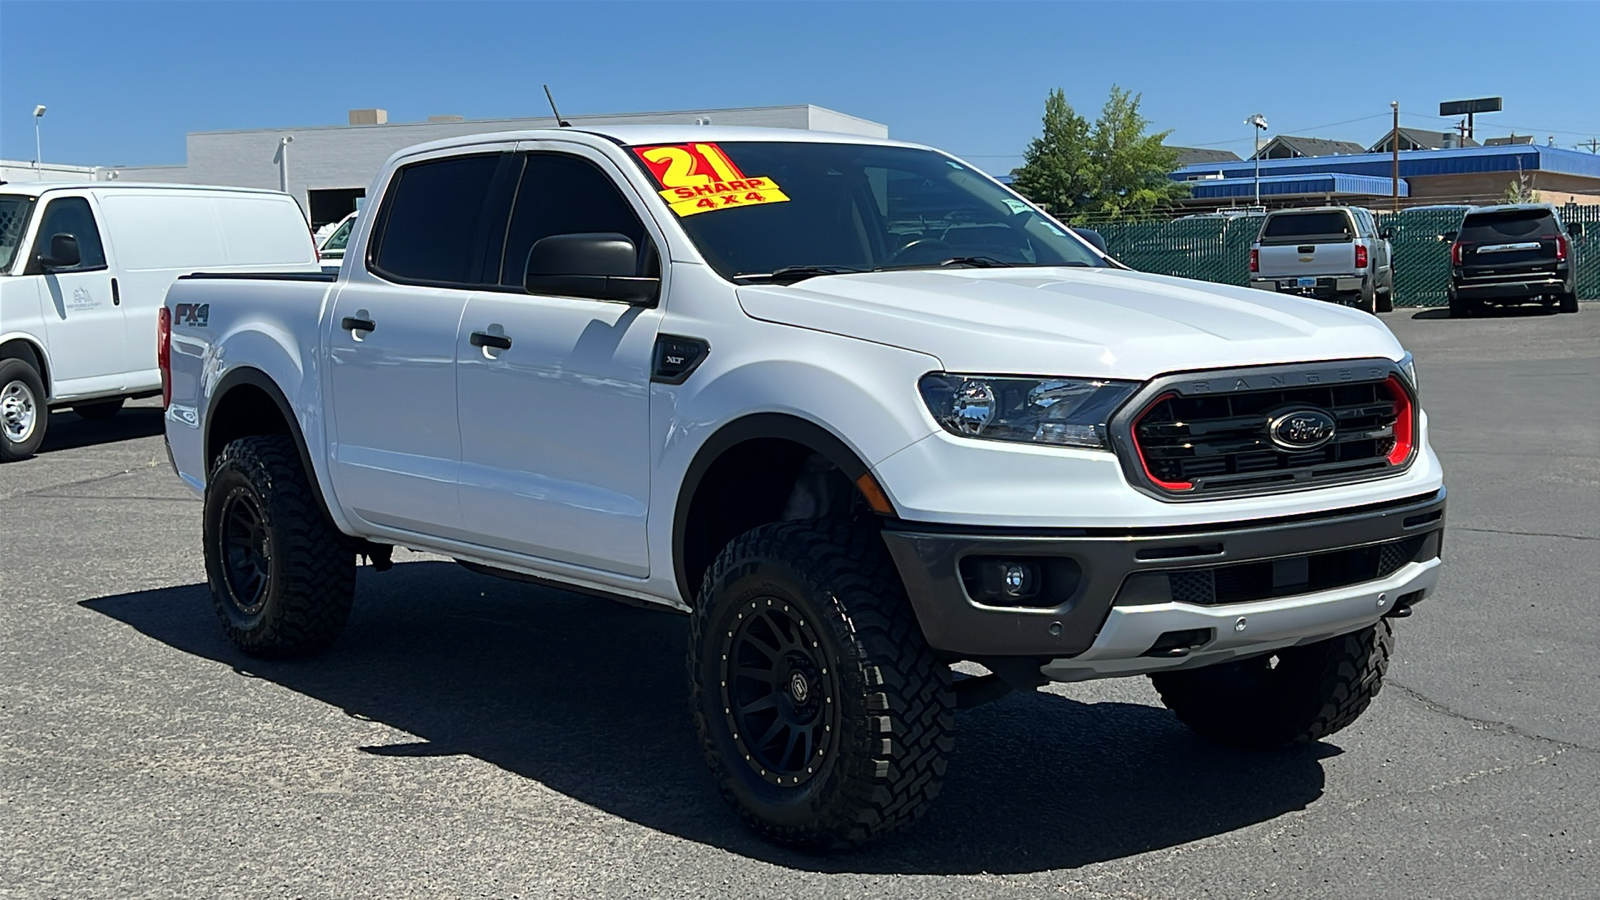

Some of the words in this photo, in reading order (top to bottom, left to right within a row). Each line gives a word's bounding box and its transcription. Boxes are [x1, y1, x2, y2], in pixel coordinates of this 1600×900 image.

[642, 144, 740, 187] 21
[674, 179, 764, 199] SHARP
[174, 303, 210, 324] FX4
[666, 355, 685, 365] XLT
[1192, 368, 1381, 393] RANGER
[1289, 417, 1326, 441] Ford
